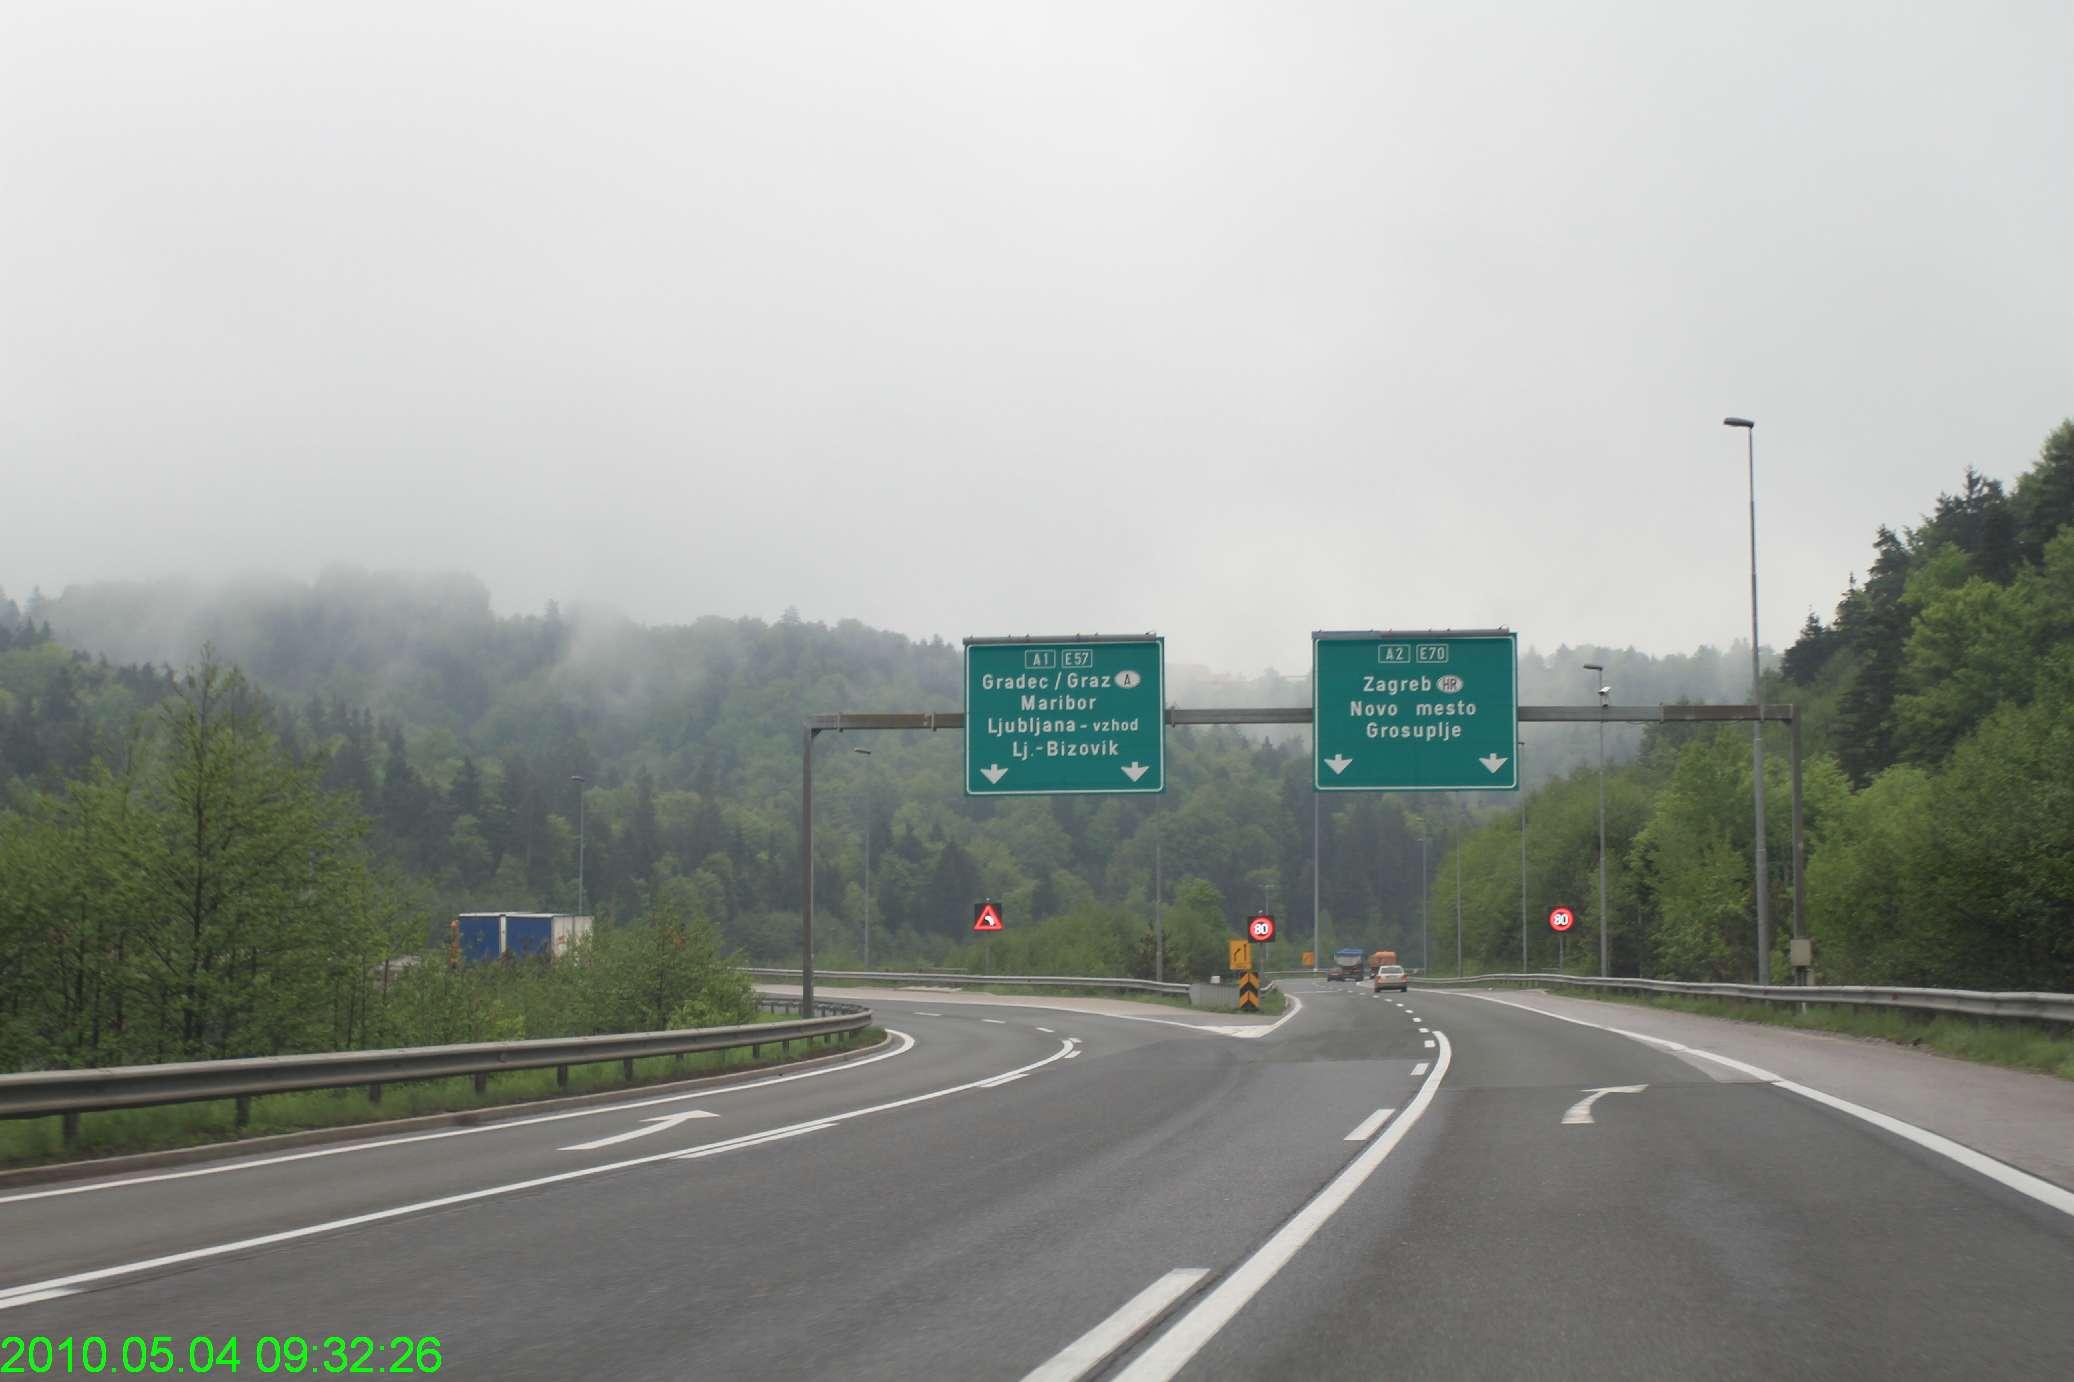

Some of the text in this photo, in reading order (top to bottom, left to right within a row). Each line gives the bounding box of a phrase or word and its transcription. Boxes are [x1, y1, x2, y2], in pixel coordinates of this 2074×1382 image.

[1033, 652, 1049, 666] A1
[1385, 646, 1445, 660] A2 E70
[1123, 673, 1132, 687] A
[1363, 675, 1457, 695] Zagreb HR
[1021, 695, 1097, 711] Maribor
[1350, 700, 1477, 716] Novo mesto
[1366, 721, 1462, 741] Grosuplje
[1554, 913, 1569, 926] 80
[1253, 922, 1269, 936] 80
